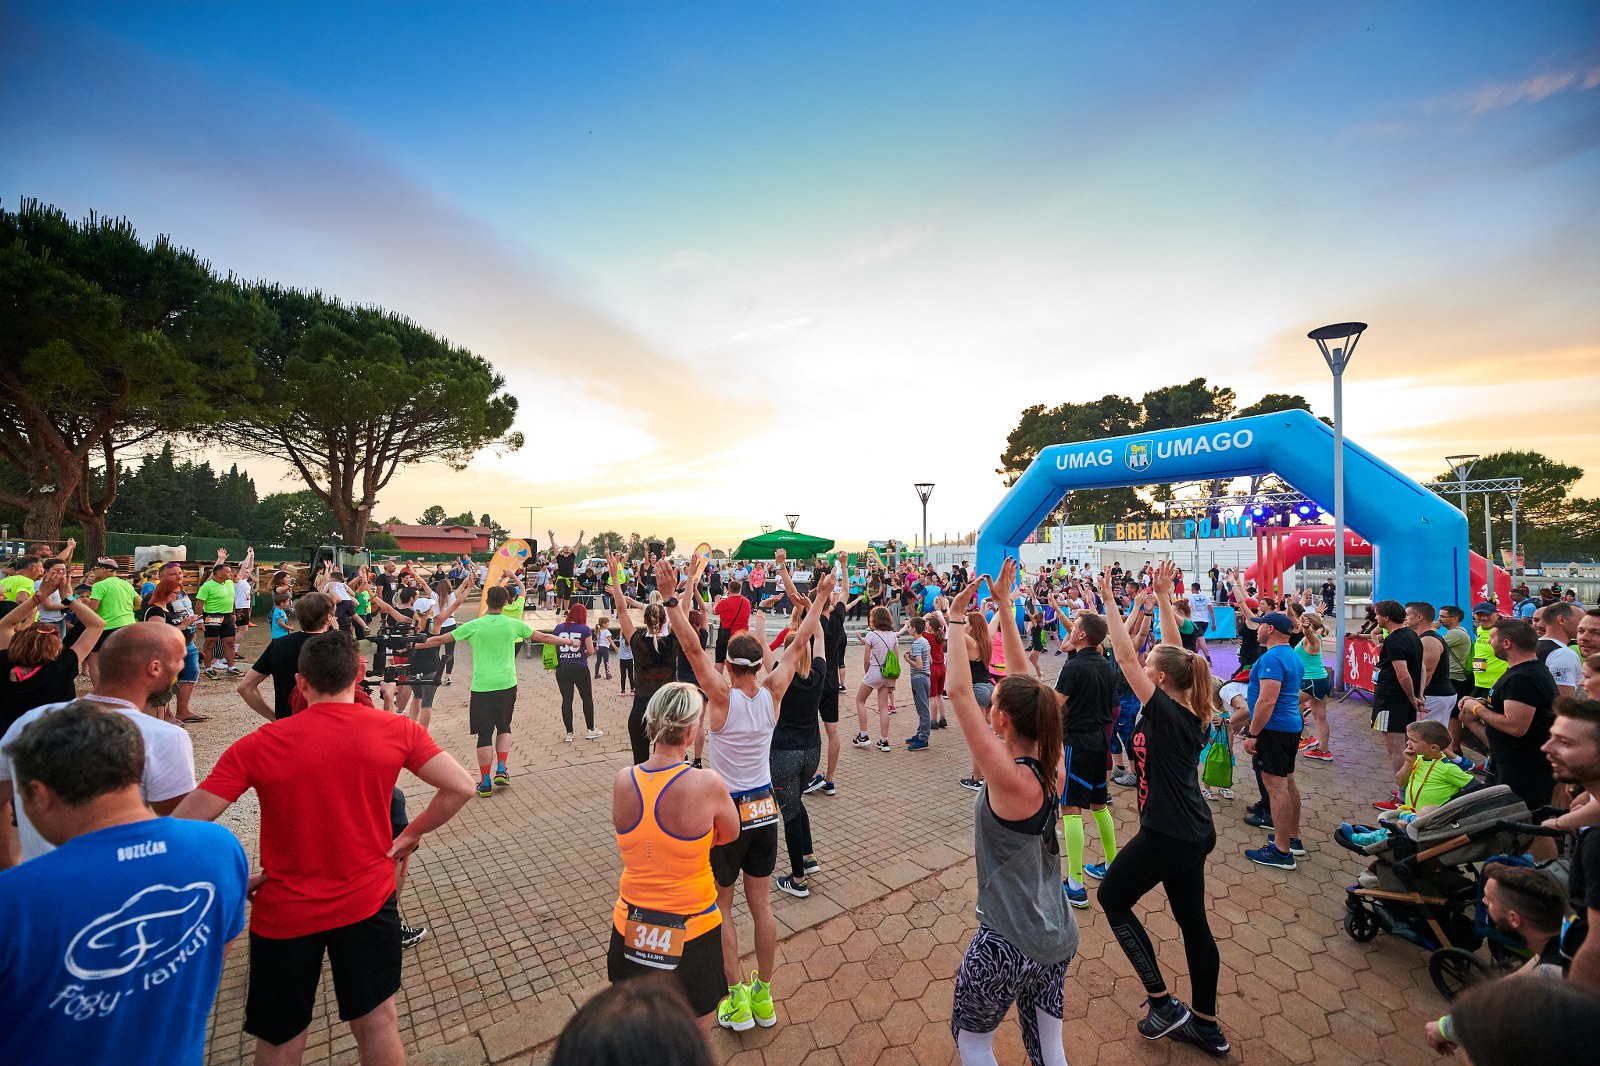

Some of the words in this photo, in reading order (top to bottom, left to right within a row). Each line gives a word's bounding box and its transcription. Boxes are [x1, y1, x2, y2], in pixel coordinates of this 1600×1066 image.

[1056, 448, 1113, 470] UMAG
[1157, 429, 1253, 459] UMAGO
[1116, 520, 1171, 541] BREAK
[1300, 537, 1336, 547] PLAV
[749, 799, 774, 819] 345
[634, 925, 672, 953] 344
